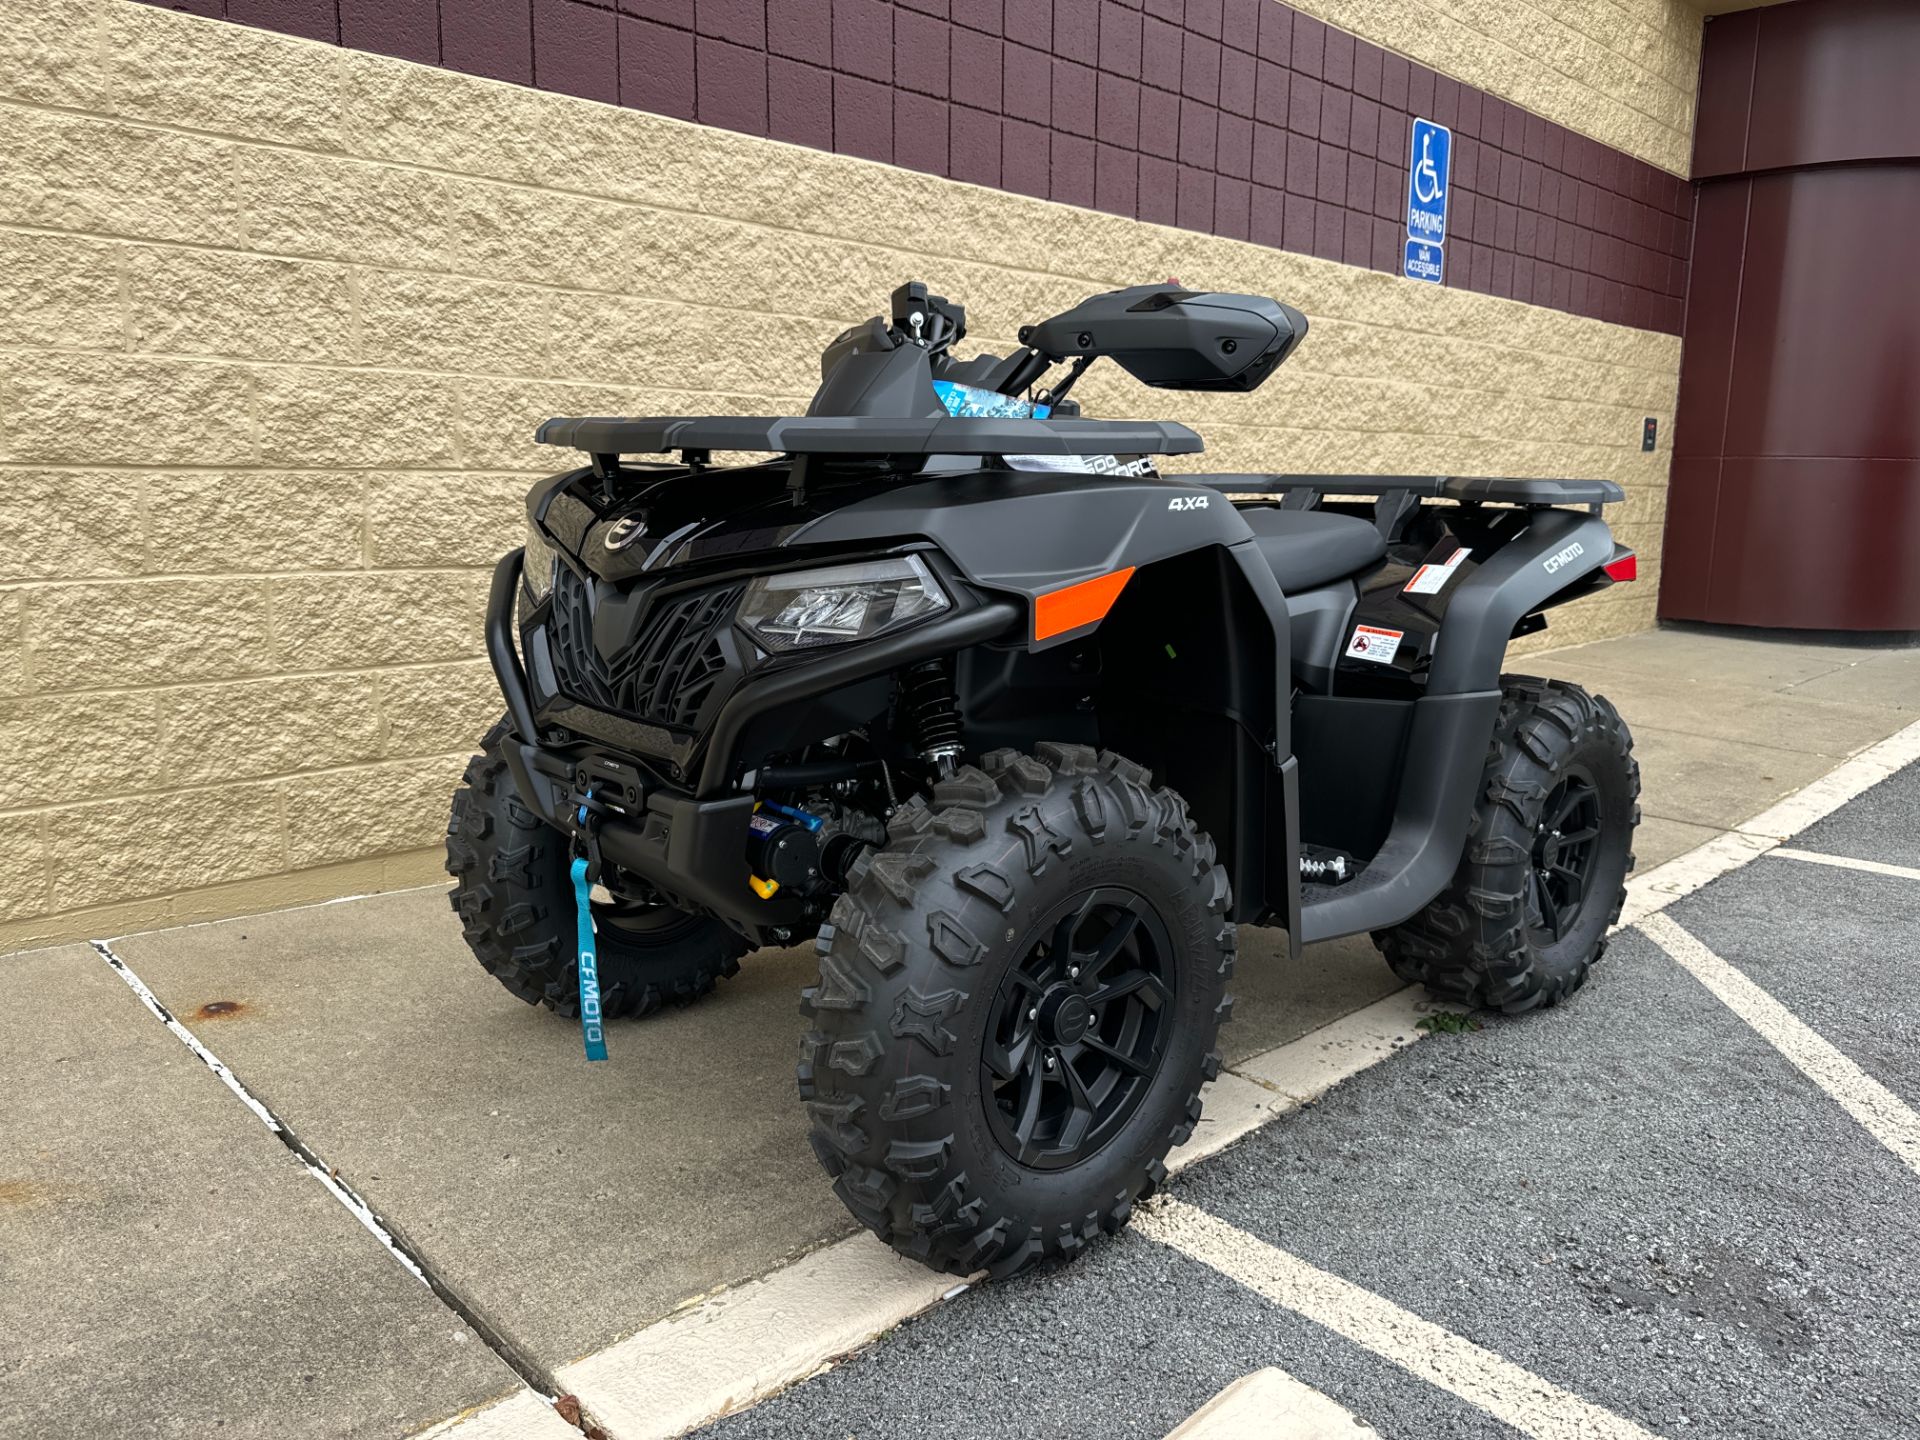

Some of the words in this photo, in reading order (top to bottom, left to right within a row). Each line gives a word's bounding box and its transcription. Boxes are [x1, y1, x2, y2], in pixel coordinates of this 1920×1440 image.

[1410, 208, 1442, 233] PARKING
[1418, 249, 1431, 262] VAN
[1408, 259, 1439, 276] ACCESSIBLE
[1085, 455, 1117, 474] 500
[1542, 542, 1584, 574] CFMOTO
[581, 951, 603, 1042] CFMOTO
